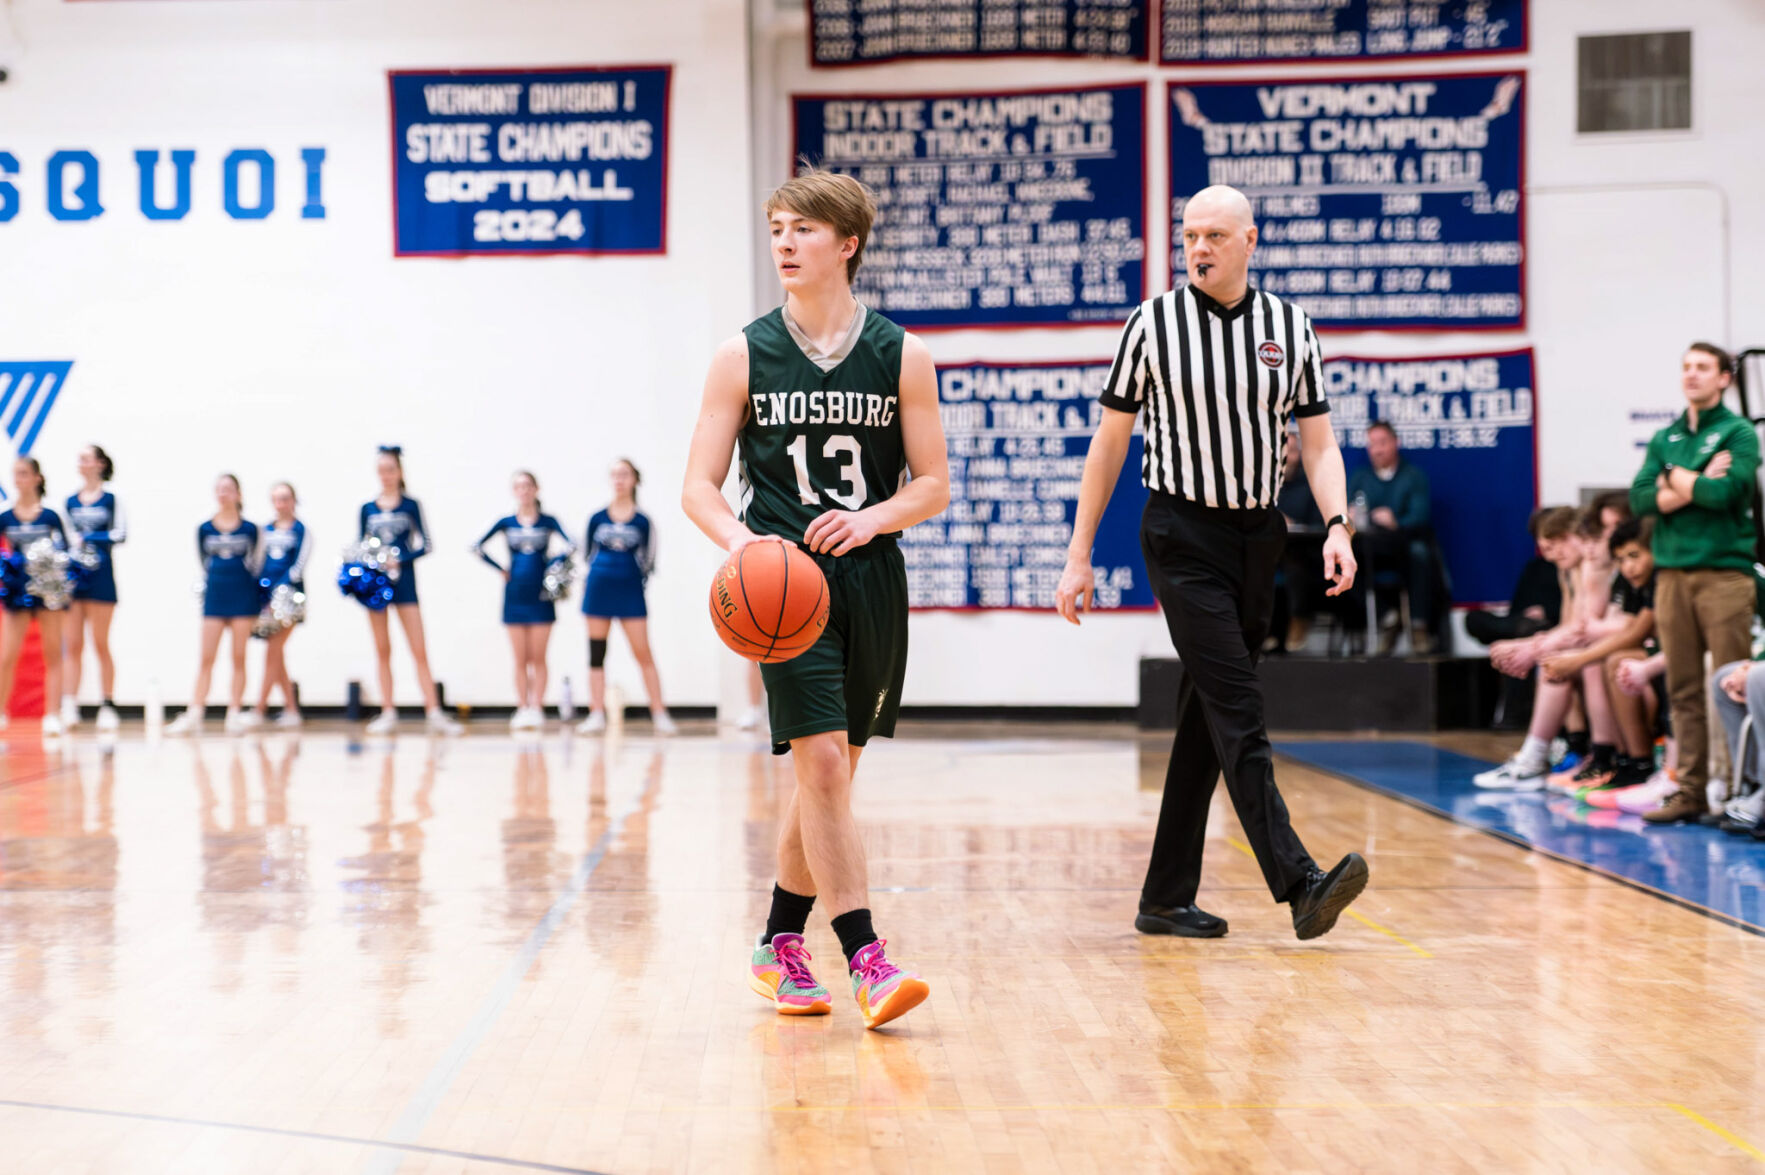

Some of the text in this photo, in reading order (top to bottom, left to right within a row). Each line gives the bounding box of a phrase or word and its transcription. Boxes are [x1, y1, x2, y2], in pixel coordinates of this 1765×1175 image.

[424, 80, 635, 115] VERMONT DIVISION I
[824, 92, 1112, 130] STATE CHAMPIONS
[1258, 84, 1436, 117] VERMONT
[407, 121, 652, 162] STATE CHAMPIONS
[824, 124, 1112, 161] INDOOR TRACK & FIELD
[1204, 117, 1488, 153] STATE CHAMPIONS
[1209, 157, 1295, 185] DIVISION
[1329, 154, 1396, 183] TRACK
[1401, 158, 1418, 182] &
[1422, 152, 1482, 182] FIELD
[425, 170, 633, 202] SOFTBALL
[473, 210, 586, 242] 2024
[1039, 222, 1079, 242] DASH
[1329, 219, 1377, 241] RELAY
[1329, 270, 1377, 293] RELAY
[1324, 358, 1500, 396] CHAMPIONS
[752, 391, 898, 428] ENOSBURG
[990, 402, 1059, 430] TRACK
[1064, 406, 1085, 429] &
[1374, 391, 1446, 421] TRACK
[1449, 394, 1468, 420] &
[1470, 387, 1534, 420] FIELD
[786, 434, 868, 511] 13
